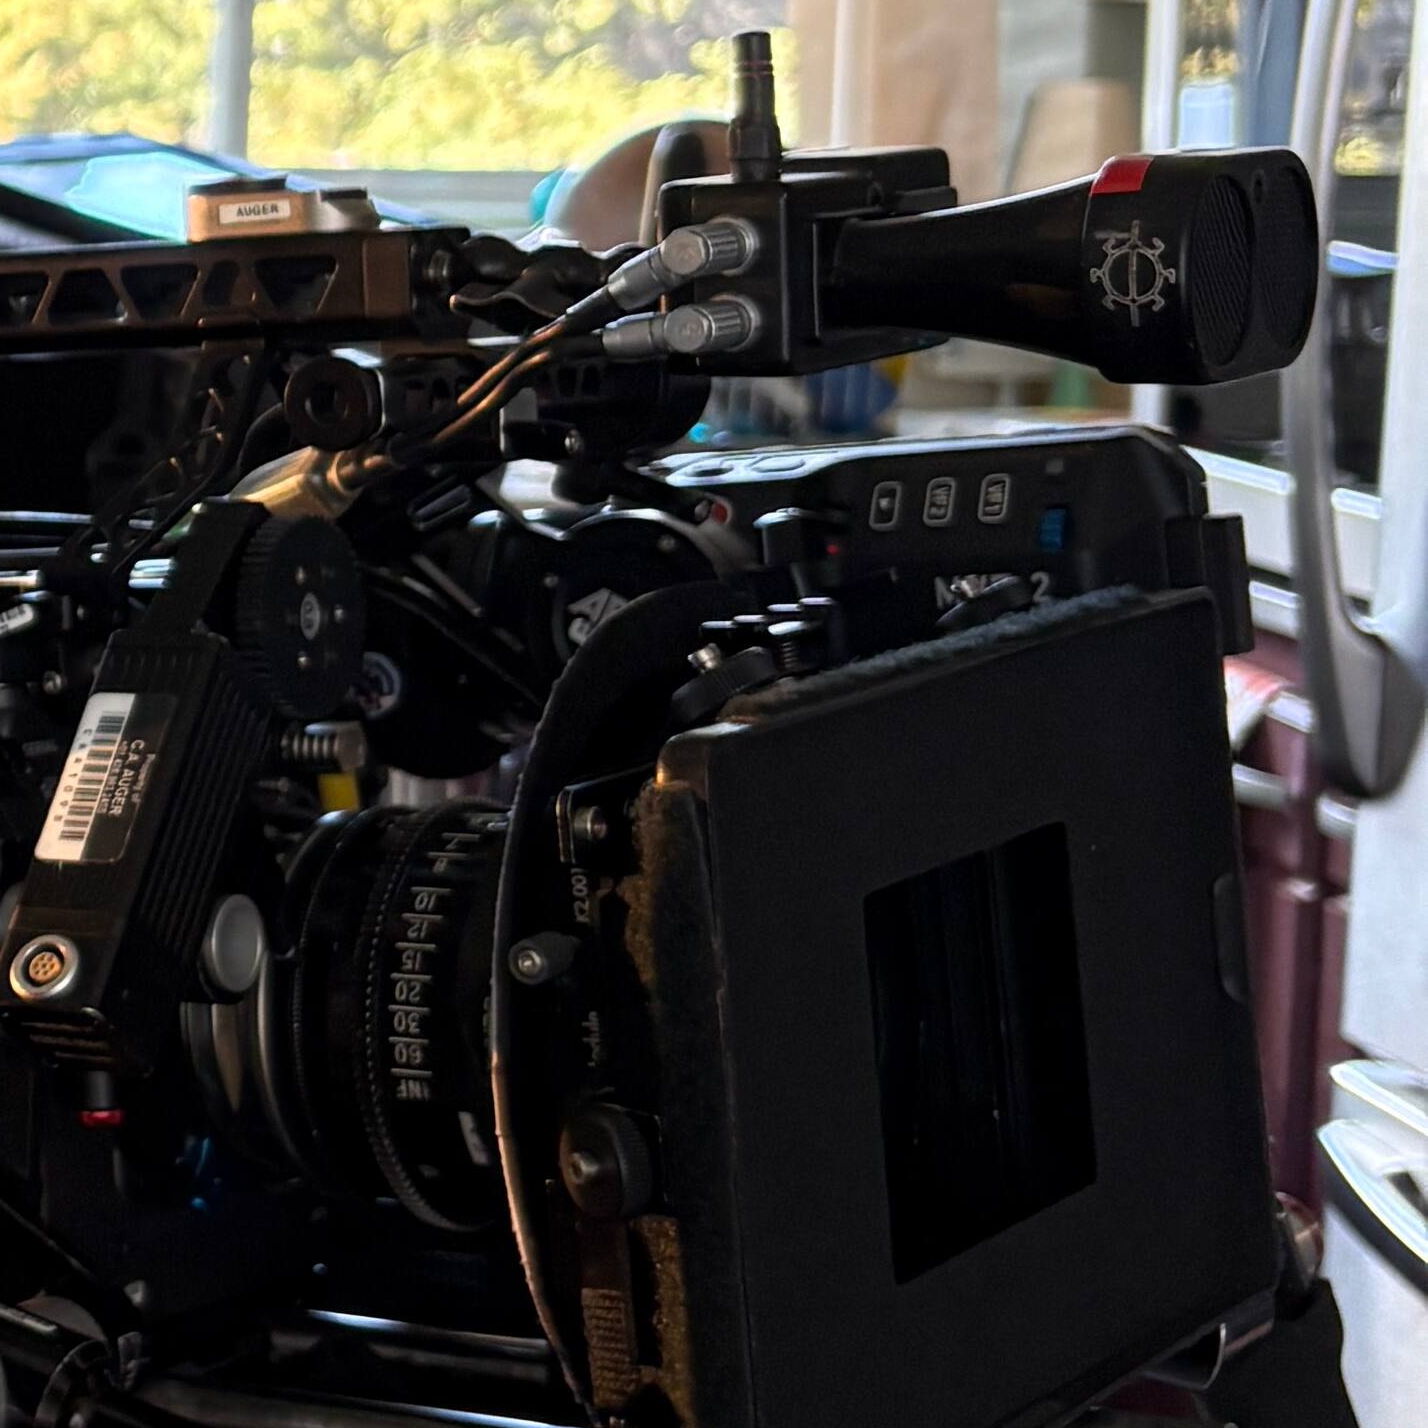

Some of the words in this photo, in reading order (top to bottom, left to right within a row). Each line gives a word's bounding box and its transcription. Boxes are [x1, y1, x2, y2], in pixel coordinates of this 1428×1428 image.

[236, 203, 279, 218] AUGER
[108, 769, 136, 817] AUGER
[415, 891, 436, 912] 10
[407, 919, 428, 939] 12
[400, 950, 421, 971] 15
[395, 980, 423, 1003] 20
[393, 1010, 421, 1033] 30
[394, 1042, 424, 1065] 60
